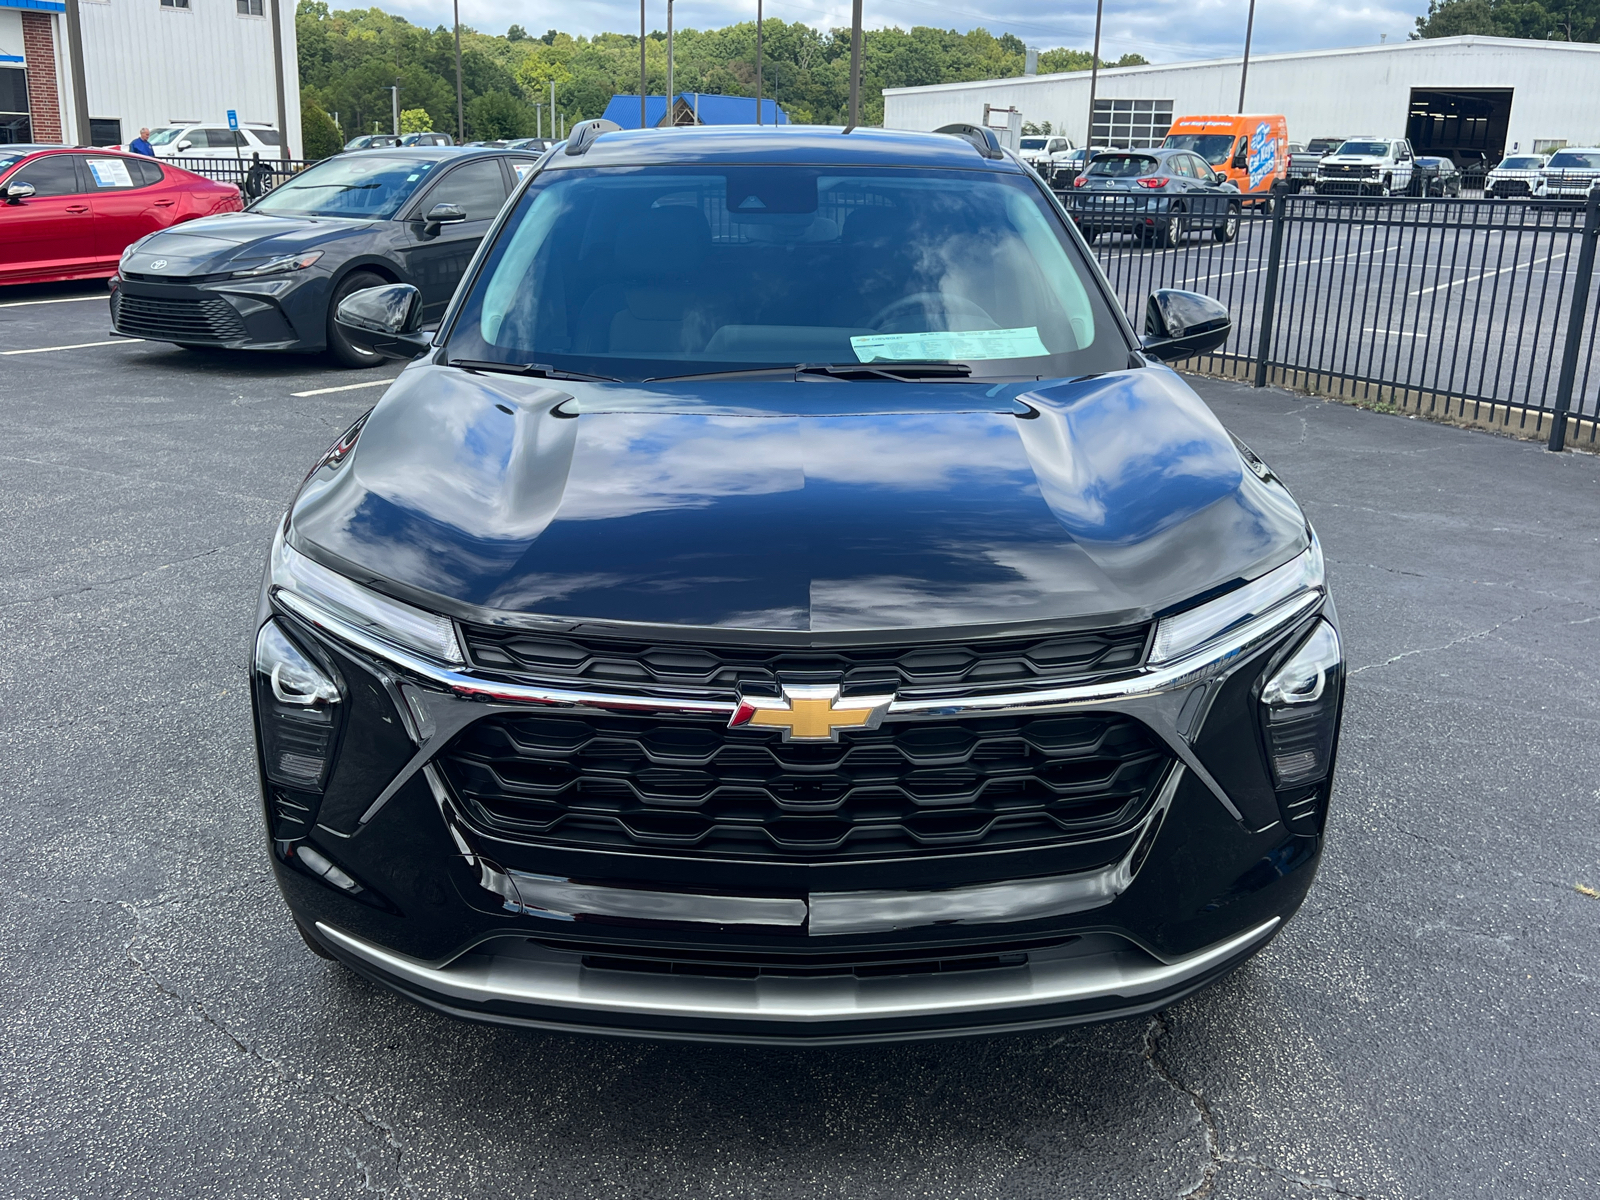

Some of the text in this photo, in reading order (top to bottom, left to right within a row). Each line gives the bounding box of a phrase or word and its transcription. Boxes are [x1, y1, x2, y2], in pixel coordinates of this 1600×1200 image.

[1249, 141, 1275, 173] Car Keys
[1249, 160, 1275, 188] Express
